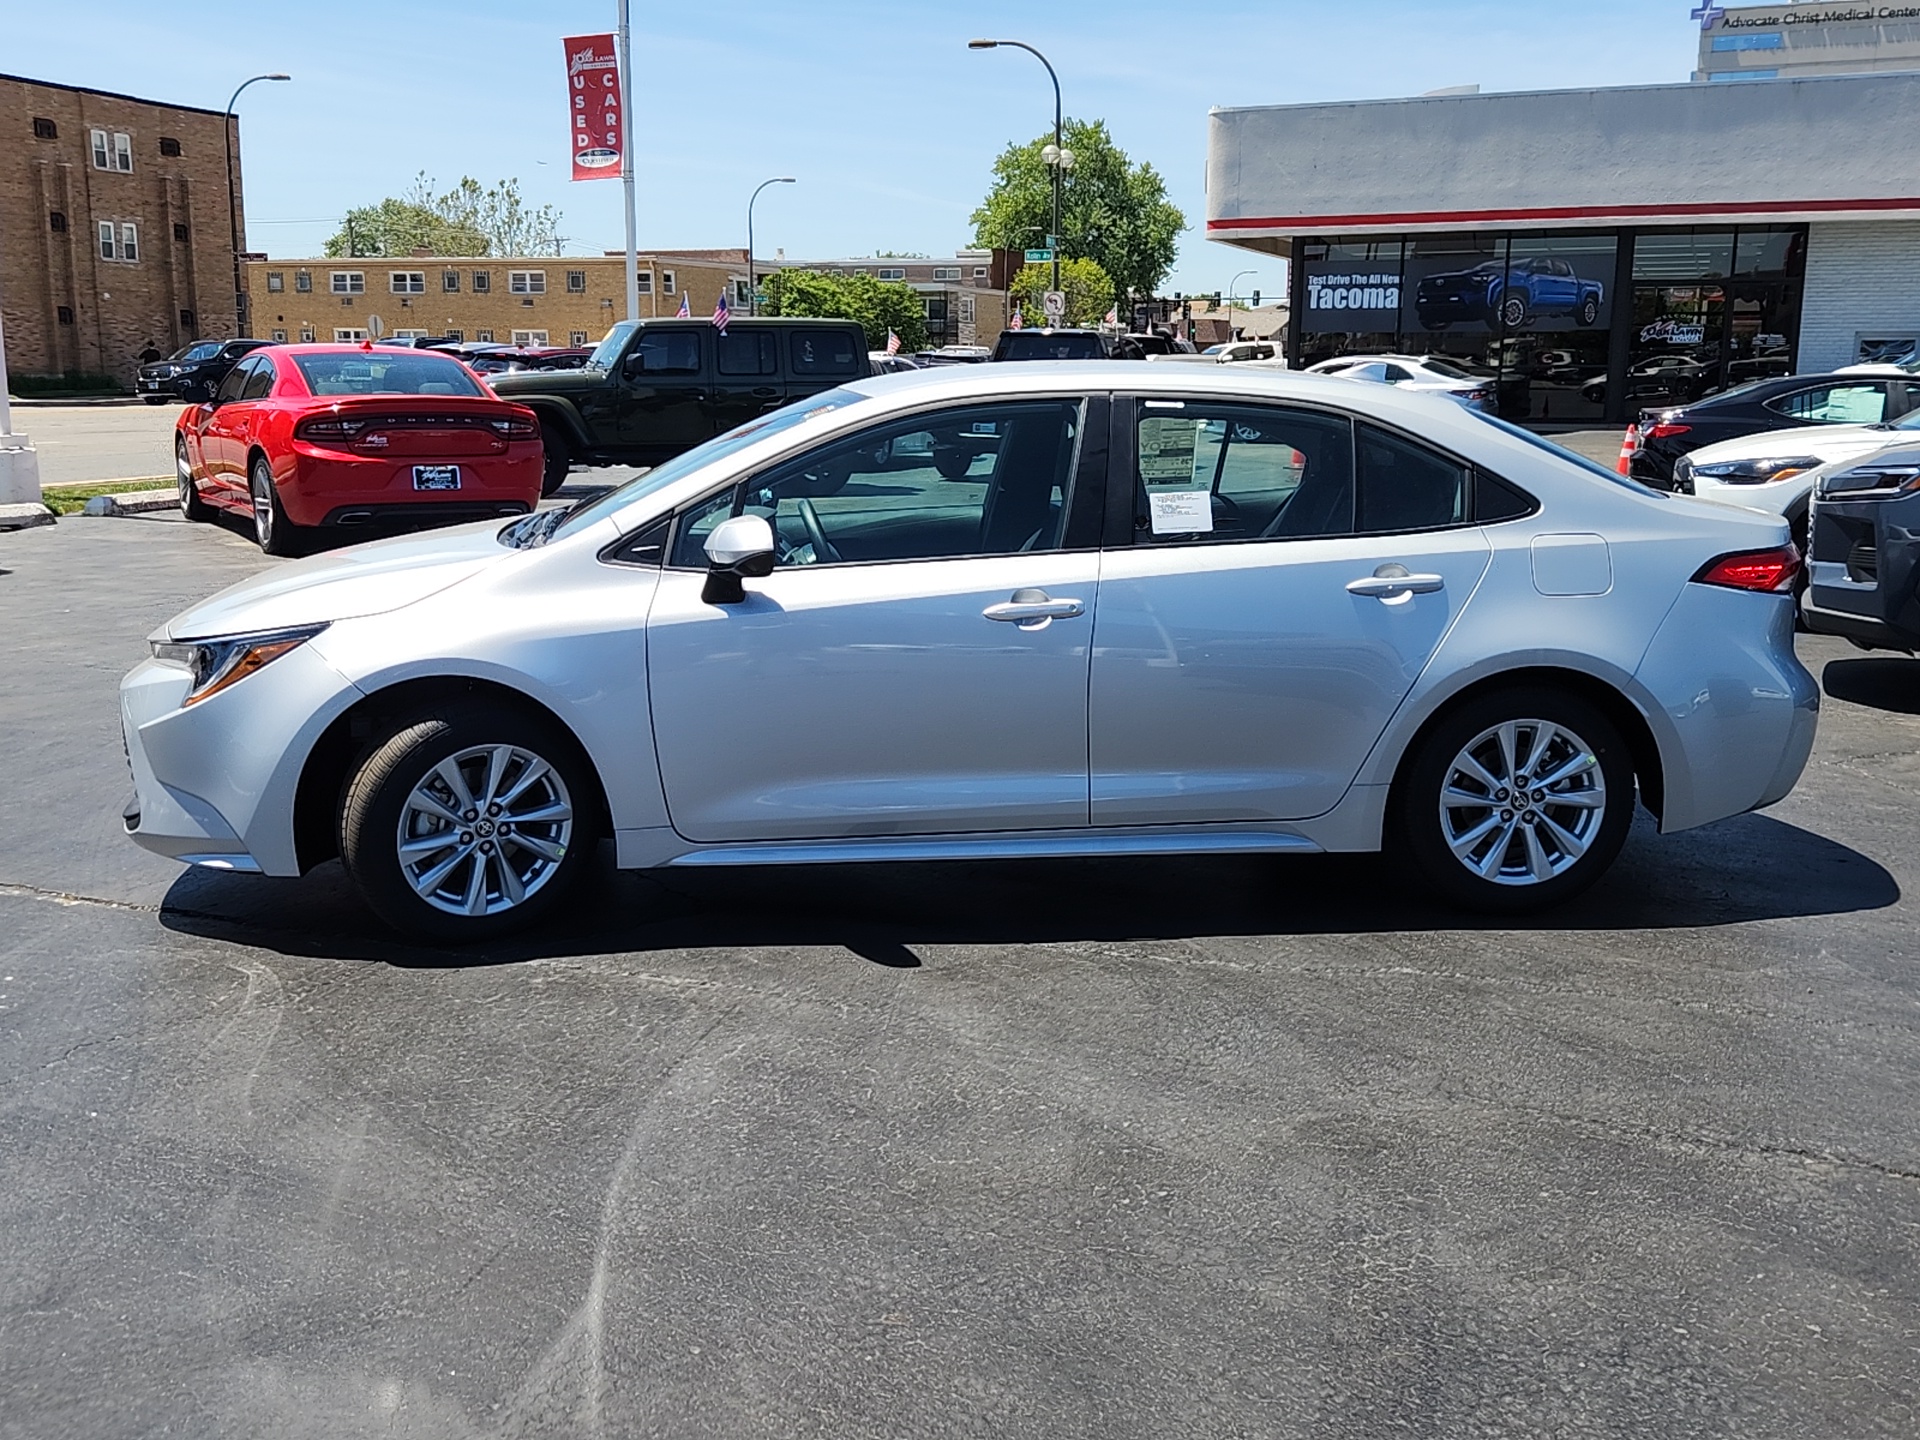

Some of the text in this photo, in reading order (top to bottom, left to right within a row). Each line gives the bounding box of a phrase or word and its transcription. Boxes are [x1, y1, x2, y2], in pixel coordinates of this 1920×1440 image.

[1722, 6, 1920, 29] Advocate Christ Medical Center
[594, 54, 615, 62] LAWN
[573, 75, 589, 147] USED
[602, 73, 618, 146] CARS
[1308, 275, 1327, 285] Test
[1327, 275, 1350, 285] Drive
[1351, 274, 1368, 285] The
[1368, 274, 1381, 285] All
[1308, 285, 1401, 309] Tacoma
